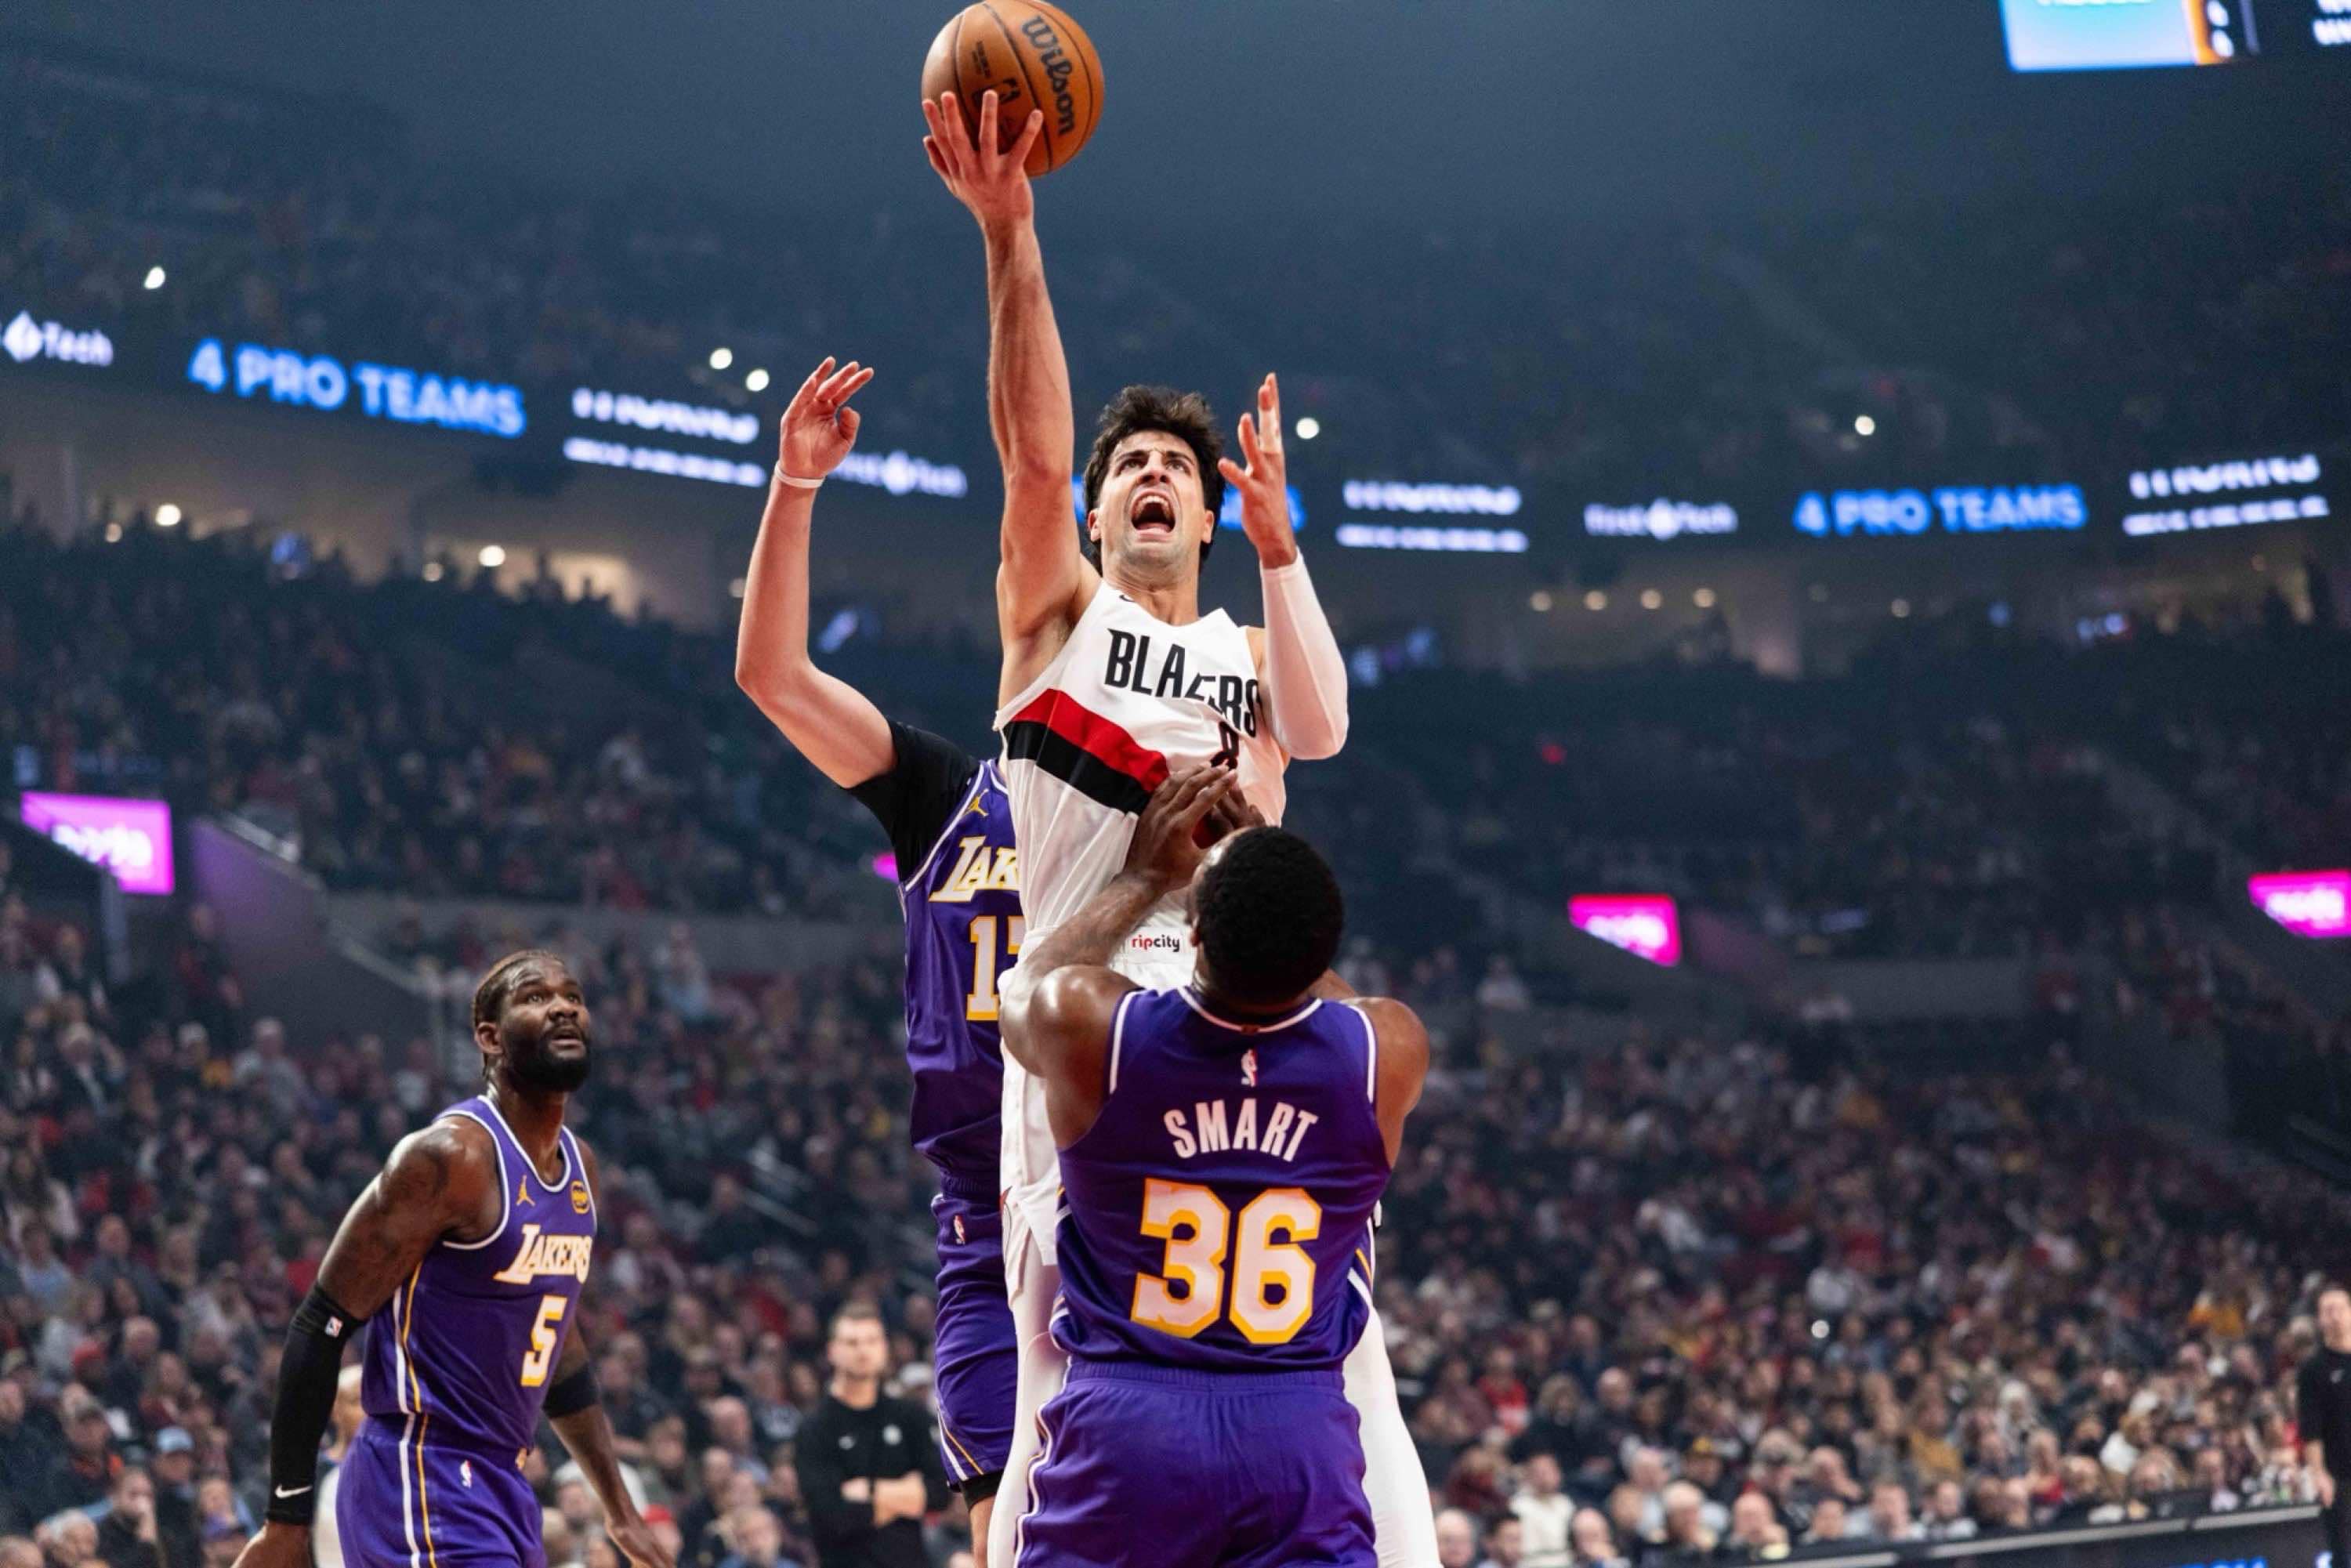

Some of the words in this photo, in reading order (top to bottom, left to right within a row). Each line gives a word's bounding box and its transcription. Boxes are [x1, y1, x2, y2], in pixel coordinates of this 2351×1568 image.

[1021, 15, 1076, 135] Wilson
[188, 337, 227, 391] 4
[237, 342, 347, 410] PRO
[353, 361, 527, 438] TEAMS
[1933, 483, 2088, 531] TEAMS
[1132, 933, 1180, 952] ripcity
[1164, 1099, 1319, 1162] SMART
[493, 1224, 592, 1284] LAKERS
[1130, 1178, 1323, 1345] 36
[520, 1295, 567, 1387] 5
